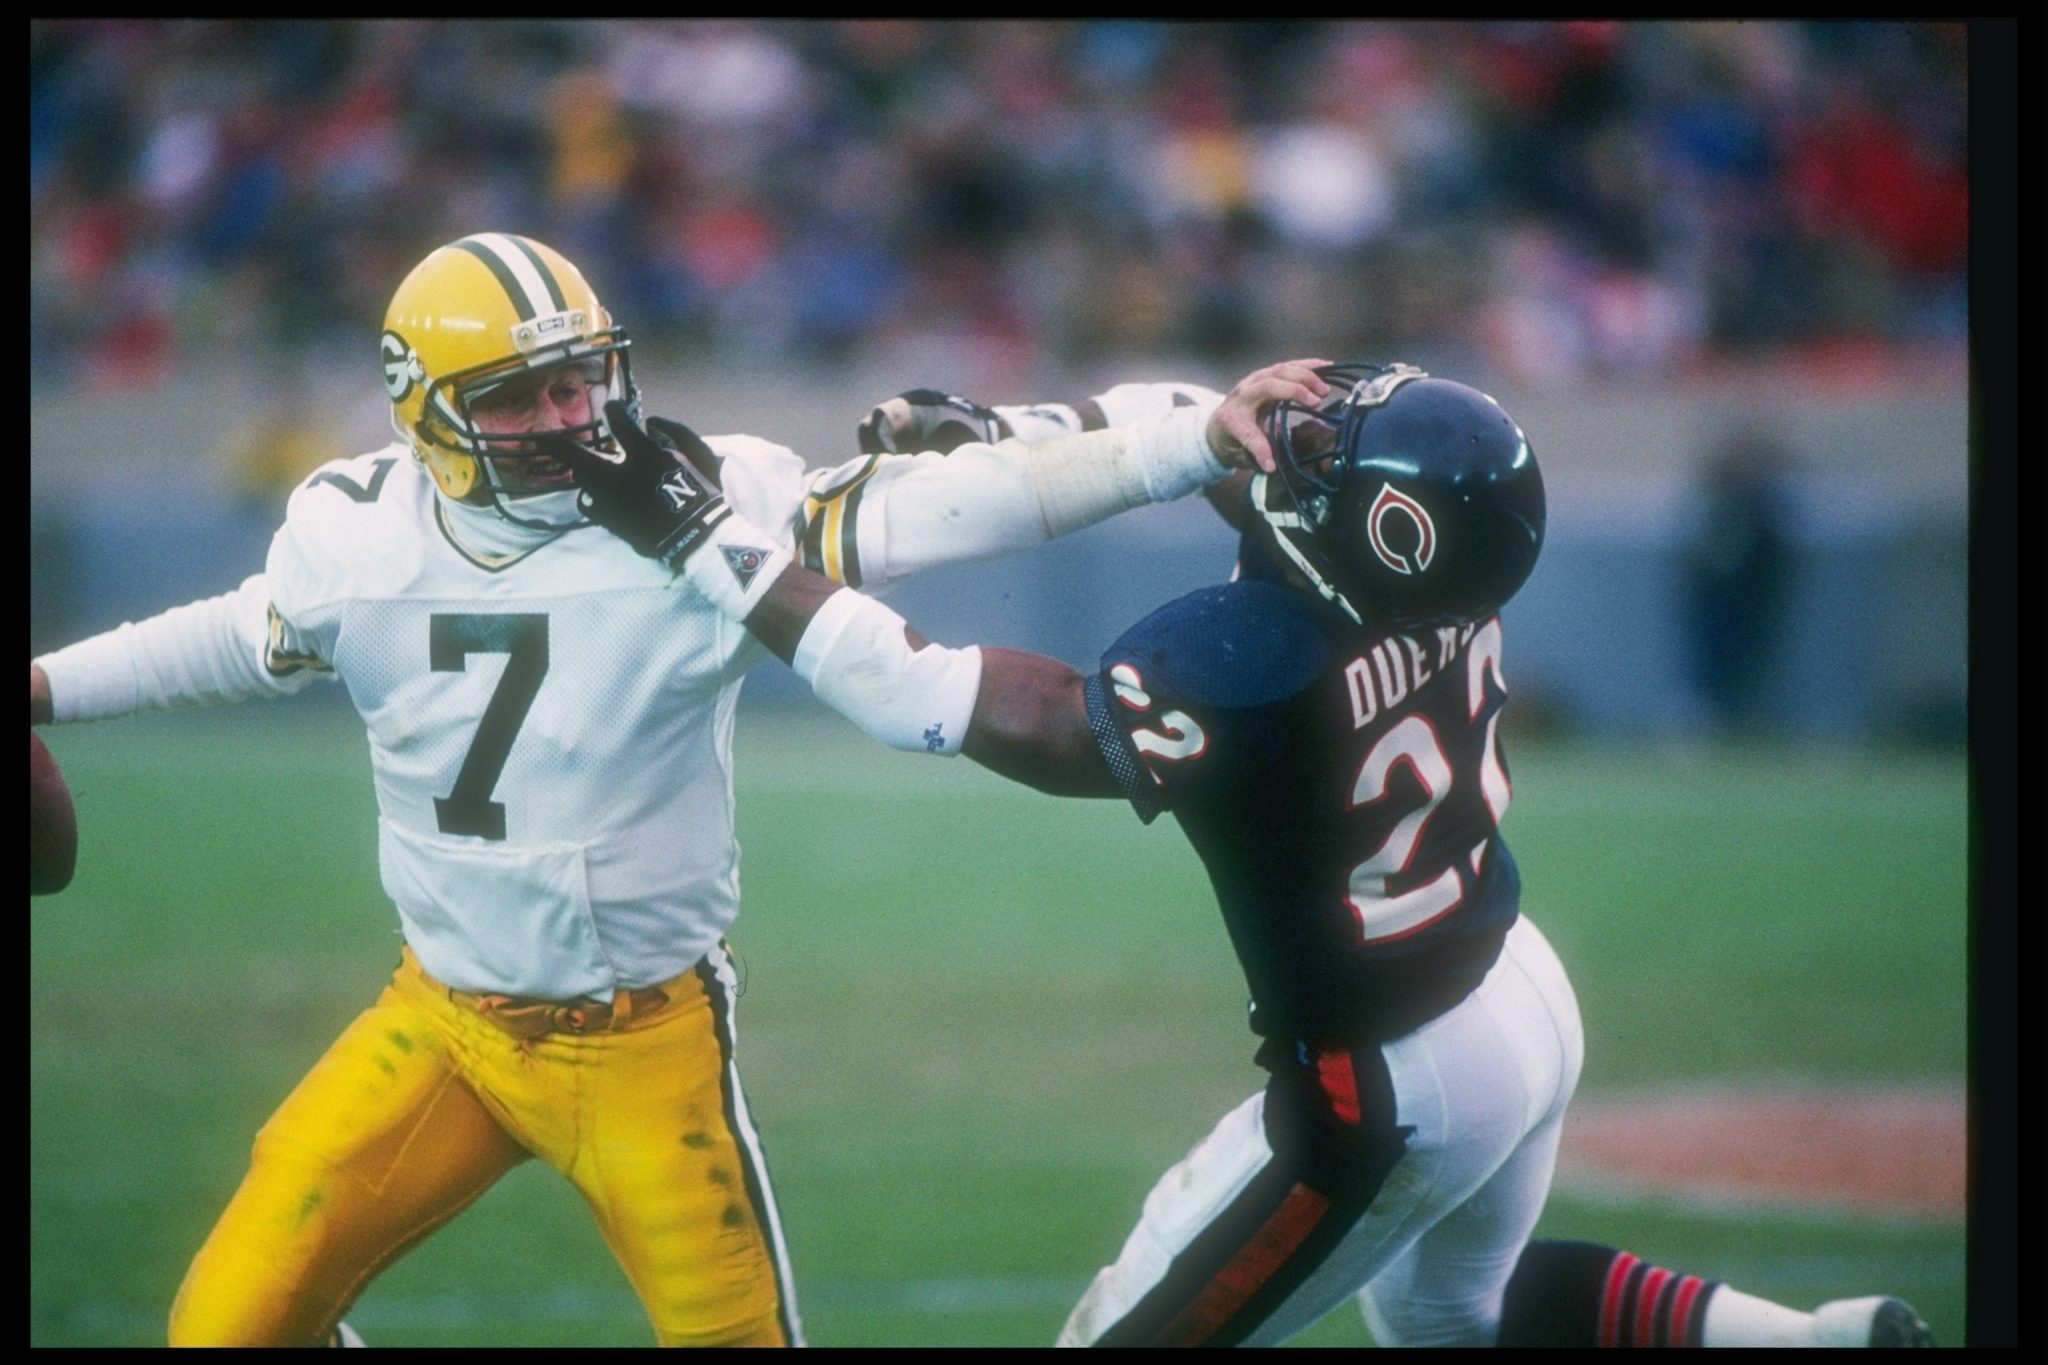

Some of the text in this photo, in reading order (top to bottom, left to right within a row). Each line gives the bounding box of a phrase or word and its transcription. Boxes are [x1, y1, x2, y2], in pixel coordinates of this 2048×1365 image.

[380, 332, 415, 402] G
[661, 471, 698, 509] N
[430, 613, 549, 841] 7
